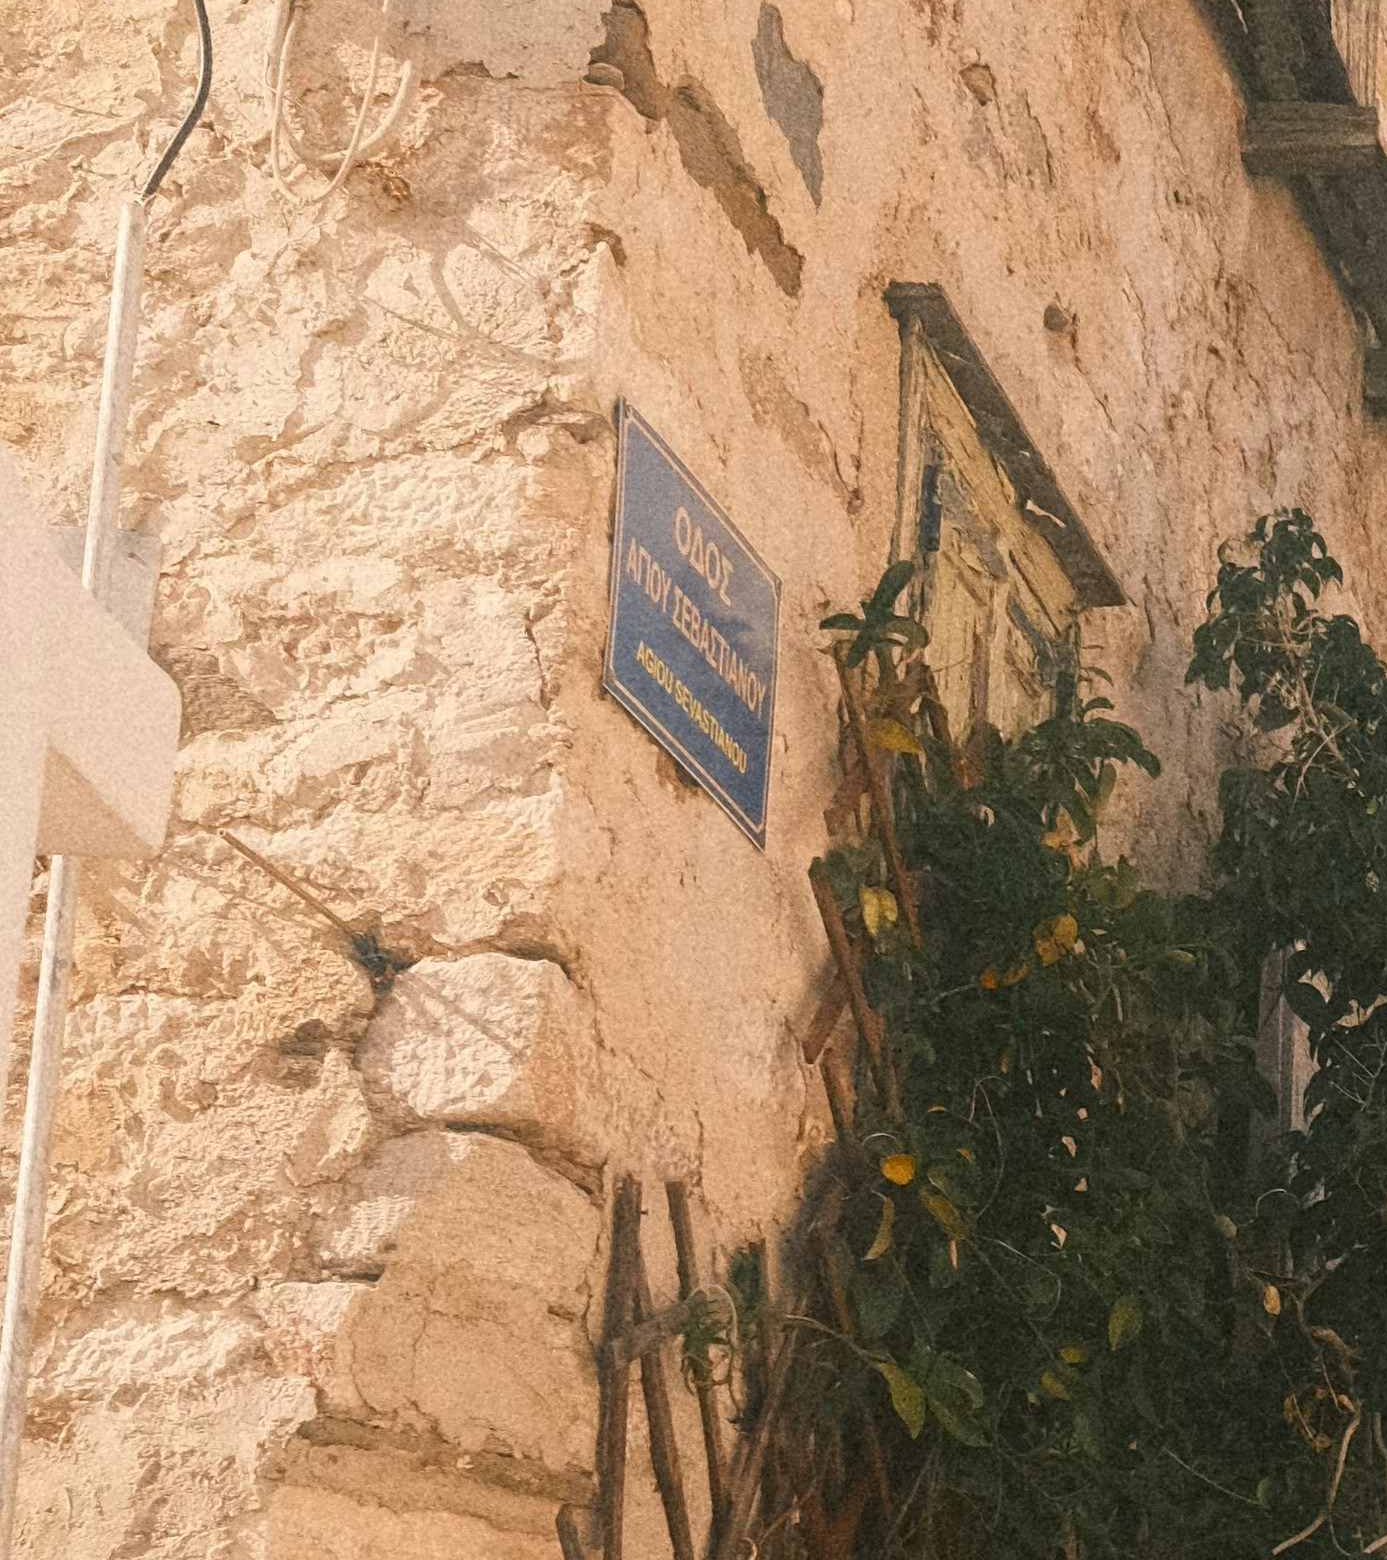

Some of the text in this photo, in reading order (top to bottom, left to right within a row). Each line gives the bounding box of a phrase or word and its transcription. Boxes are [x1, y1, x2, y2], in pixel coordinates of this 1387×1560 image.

[674, 506, 734, 608] ΟΔΟΣ
[626, 537, 768, 721] ΑΓΙΟΥ ΣΕΒΑΣΤΙΑΝΟΥ
[636, 640, 748, 775] AGIOU SEVASTIANOU
